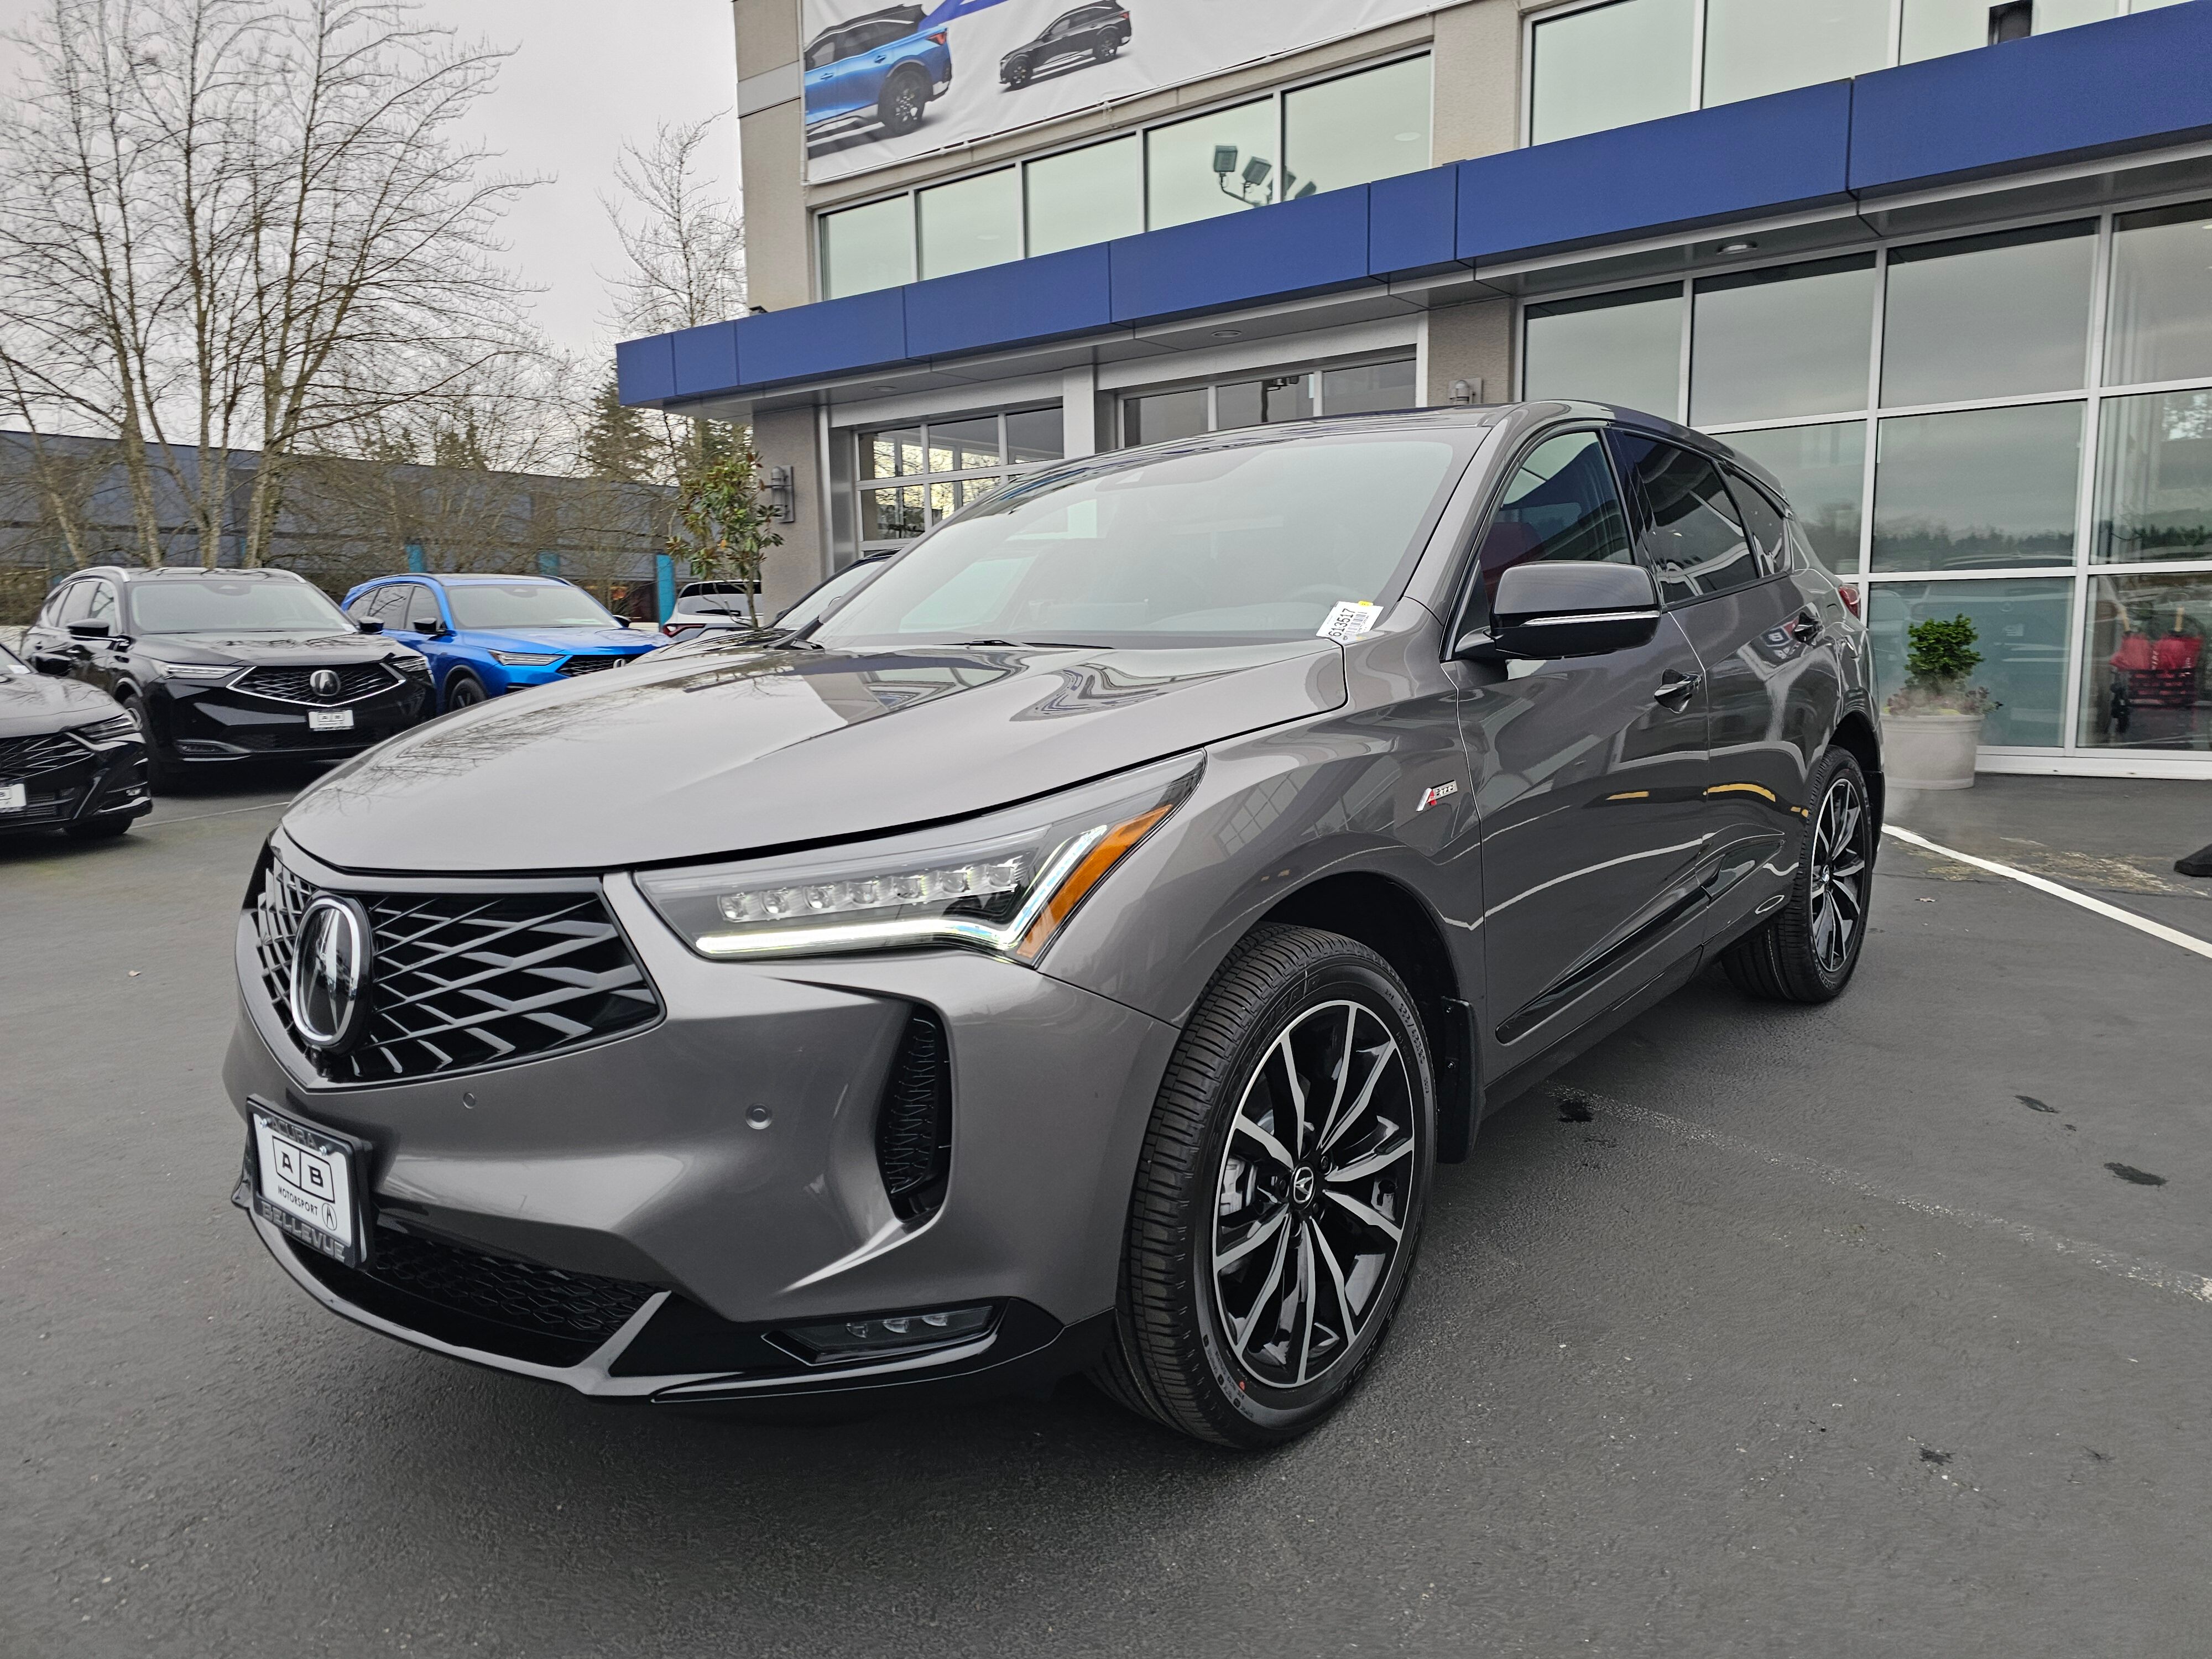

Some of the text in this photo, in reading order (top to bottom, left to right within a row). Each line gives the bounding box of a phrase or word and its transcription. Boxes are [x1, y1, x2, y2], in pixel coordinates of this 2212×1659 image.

[1328, 608, 1355, 637] 613517
[269, 1117, 319, 1150] ACURA
[281, 1151, 324, 1187] A B
[278, 1185, 318, 1215] MOTORSPORT
[262, 1201, 345, 1262] BELLEVUE
